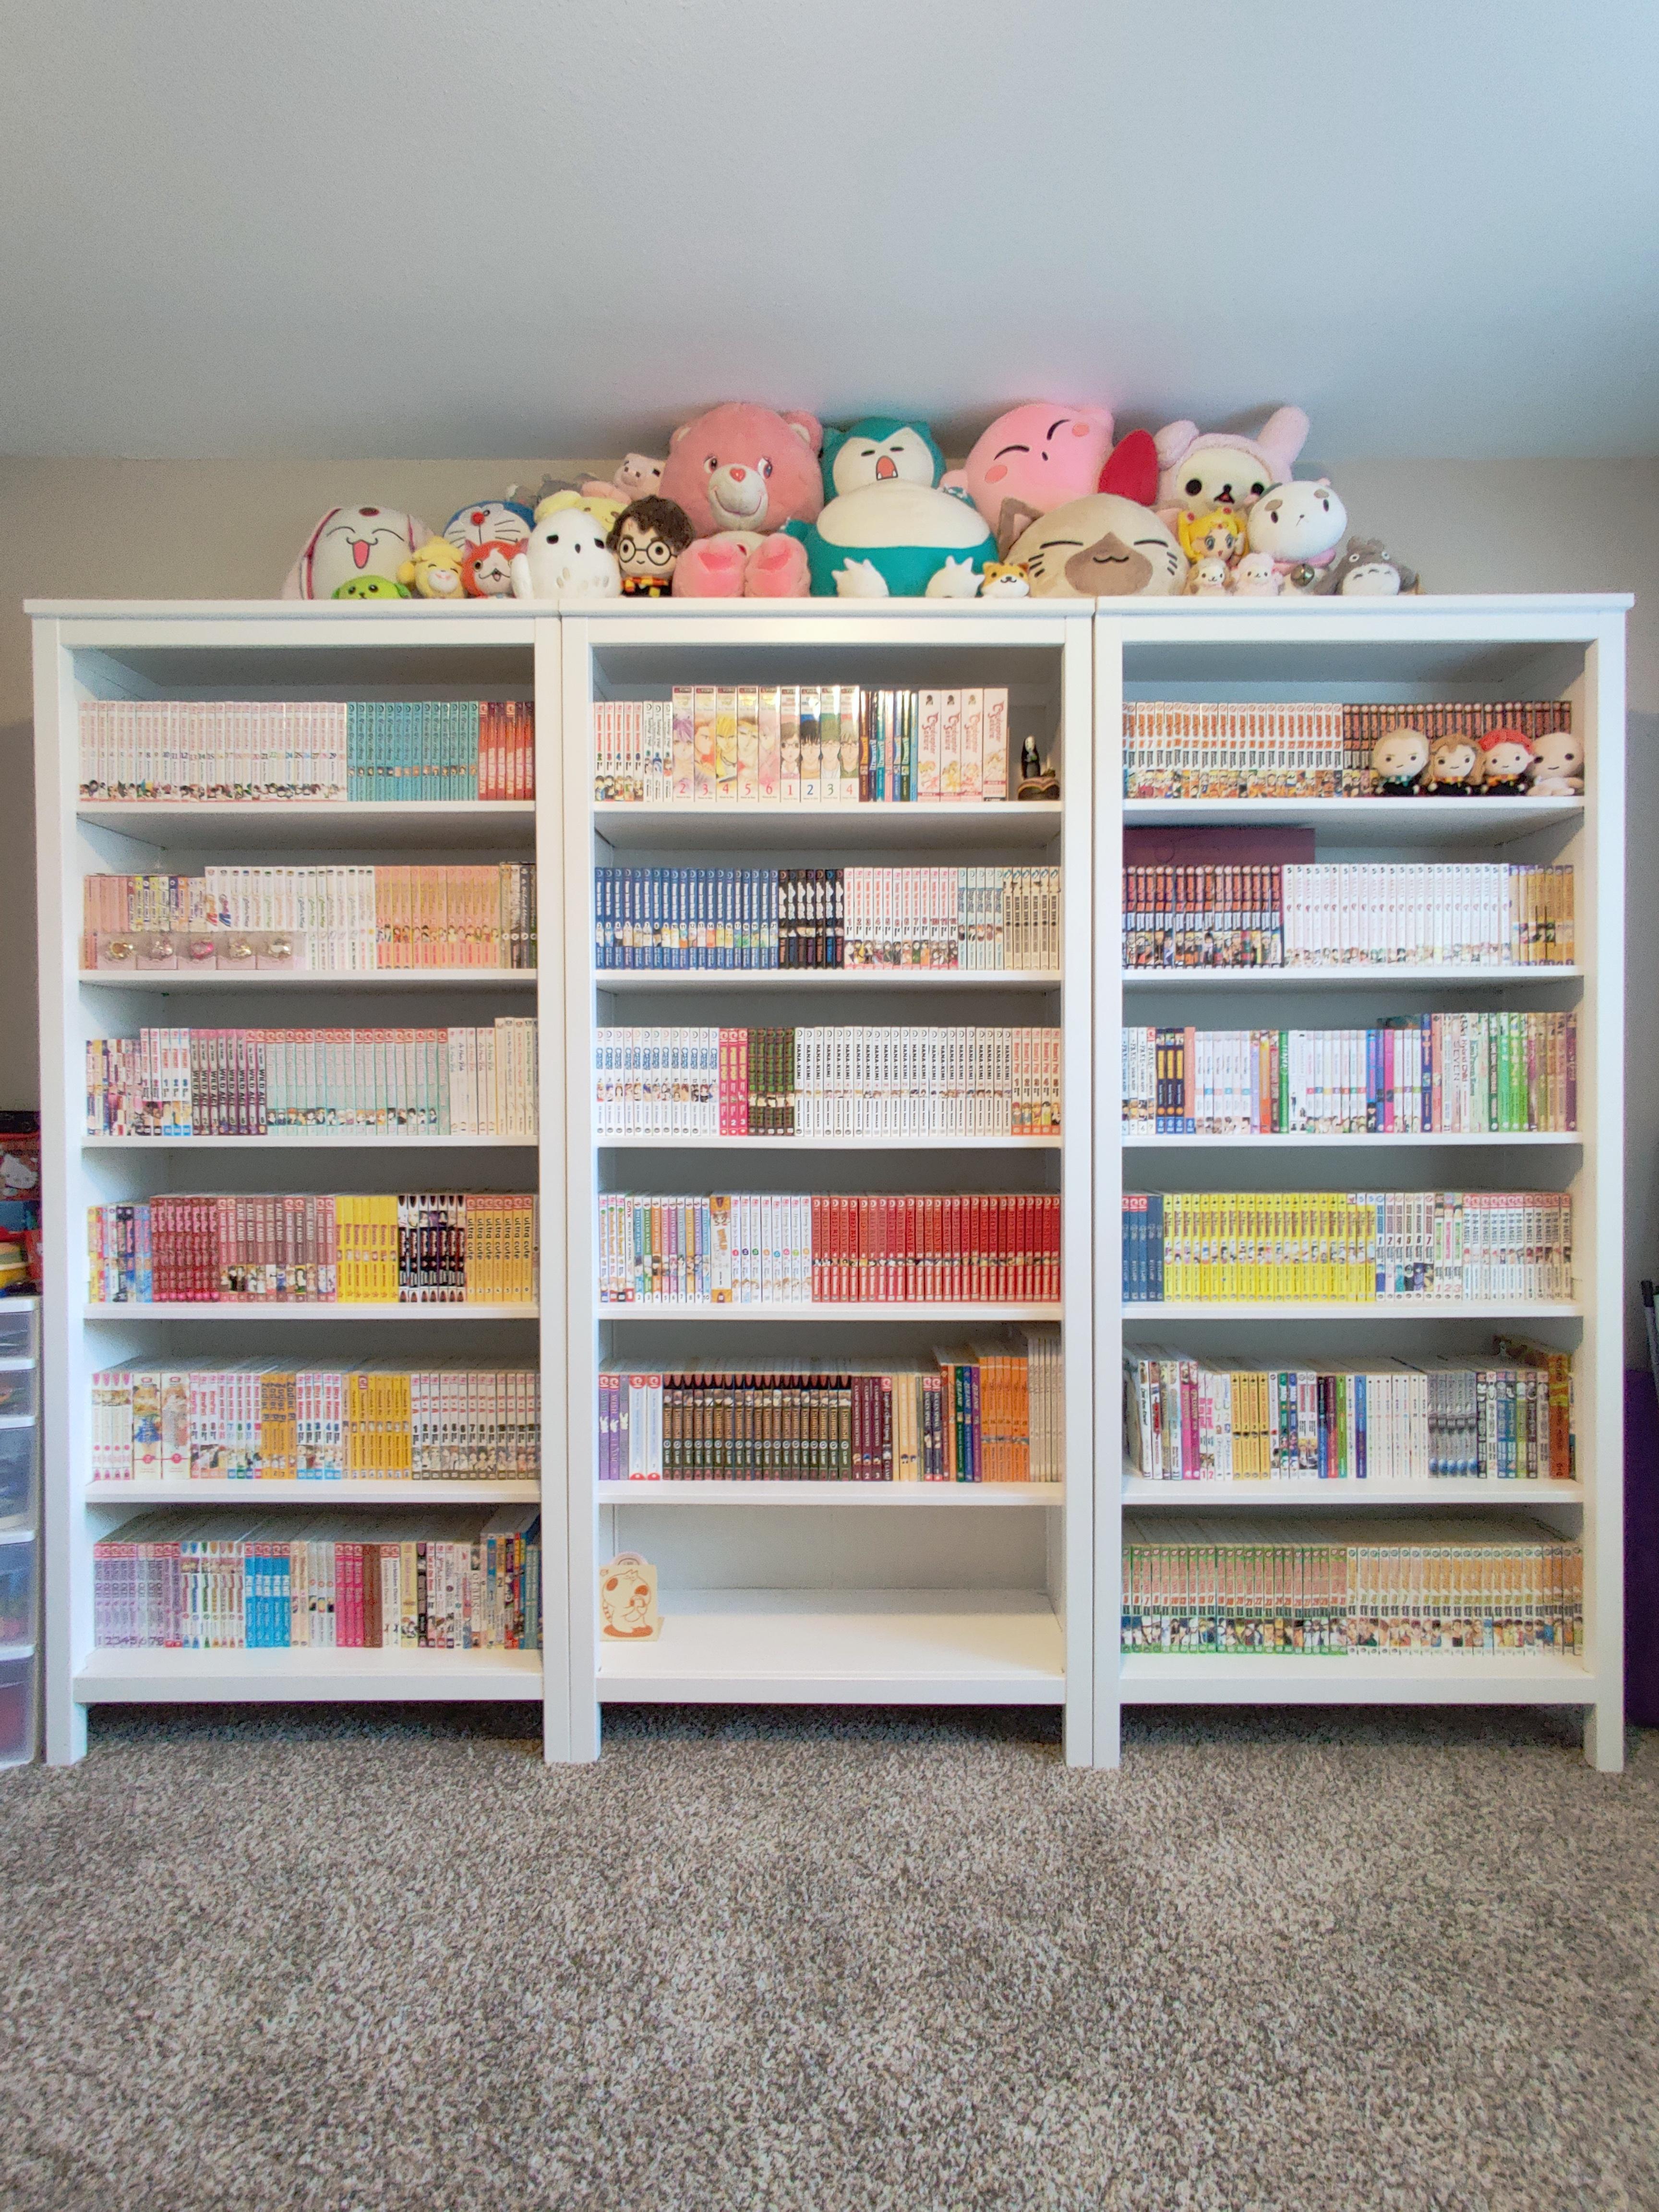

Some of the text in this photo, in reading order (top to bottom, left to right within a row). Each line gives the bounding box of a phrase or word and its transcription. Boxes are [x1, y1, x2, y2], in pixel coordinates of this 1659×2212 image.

[680, 784, 685, 793] 2
[703, 784, 709, 794] 3
[723, 784, 729, 794] 4
[745, 784, 751, 795] 5
[766, 784, 772, 794] 6
[788, 785, 792, 795] 1
[807, 785, 813, 794] 2
[828, 784, 833, 795] 3
[847, 784, 852, 794] 4
[1427, 1237, 1431, 1245] 7
[498, 1578, 502, 1587] 2
